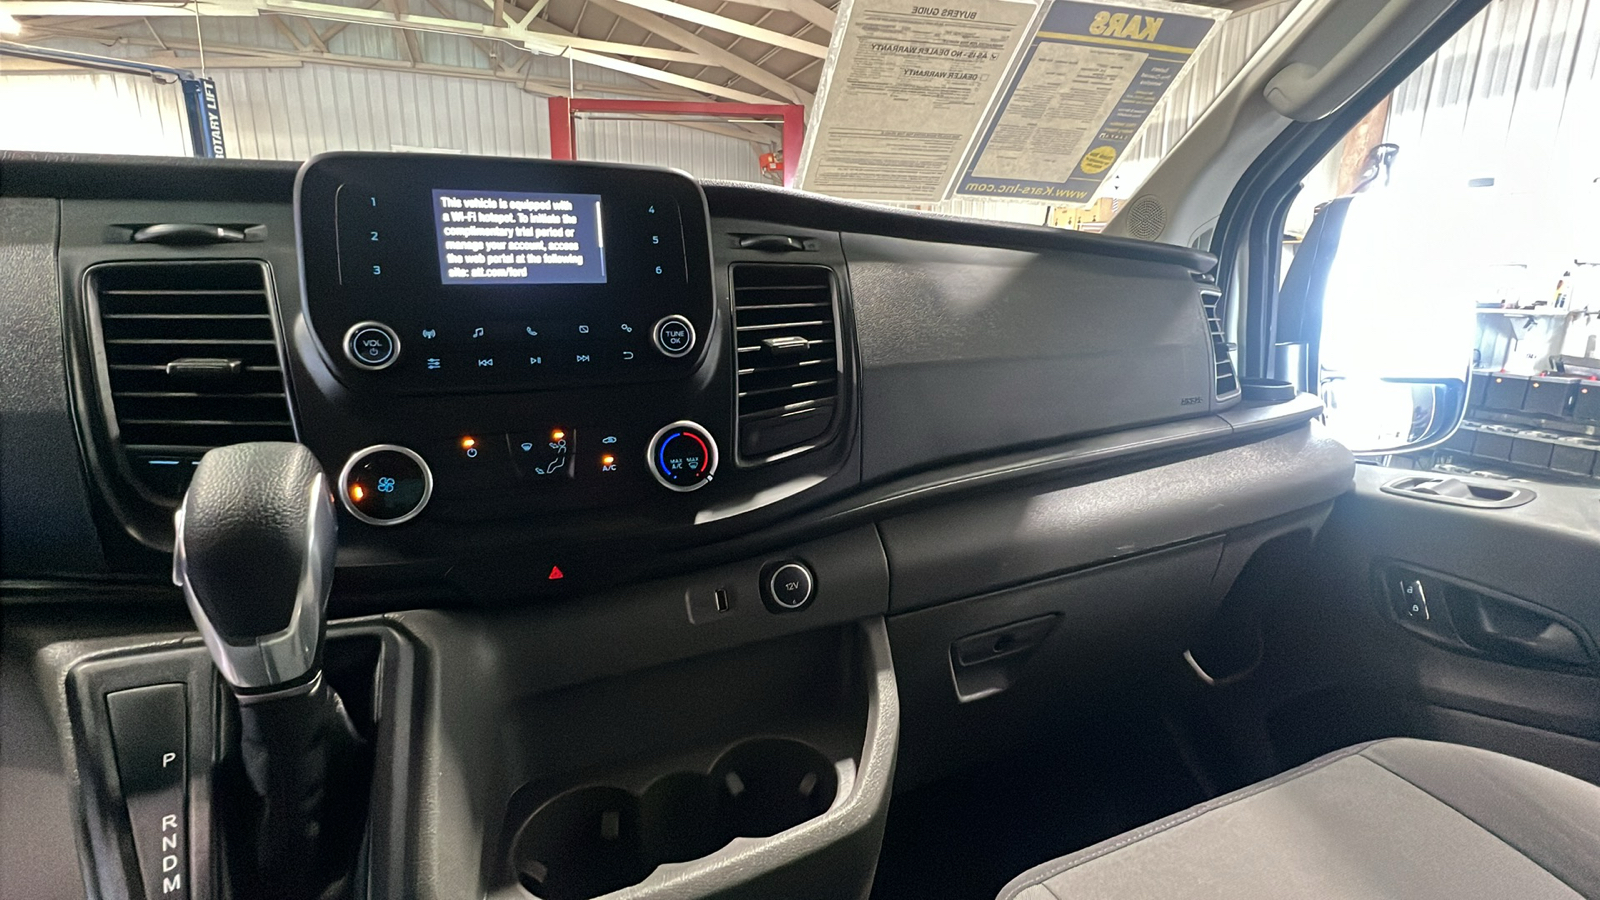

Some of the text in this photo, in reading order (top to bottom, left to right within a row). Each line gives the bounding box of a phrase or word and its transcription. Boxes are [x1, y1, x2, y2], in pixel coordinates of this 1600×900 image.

[204, 80, 217, 110] LIFT
[371, 197, 376, 207] 1
[440, 196, 572, 212] This vehicle is equipped with
[648, 206, 655, 214] 4
[442, 212, 577, 224] a Wi-Fi hotspot. To initiate the
[371, 231, 379, 241] 2
[443, 226, 575, 238] complimentary trial period or
[445, 240, 579, 252] manage your account, access
[652, 235, 659, 245] 5
[446, 253, 583, 266] the web portal at the following
[372, 266, 381, 275] 3
[655, 266, 662, 275] 6
[785, 581, 799, 591] 12V
[162, 752, 176, 768] P
[162, 814, 178, 831] R
[162, 833, 178, 851] N
[162, 855, 177, 873] D
[163, 874, 181, 894] M
